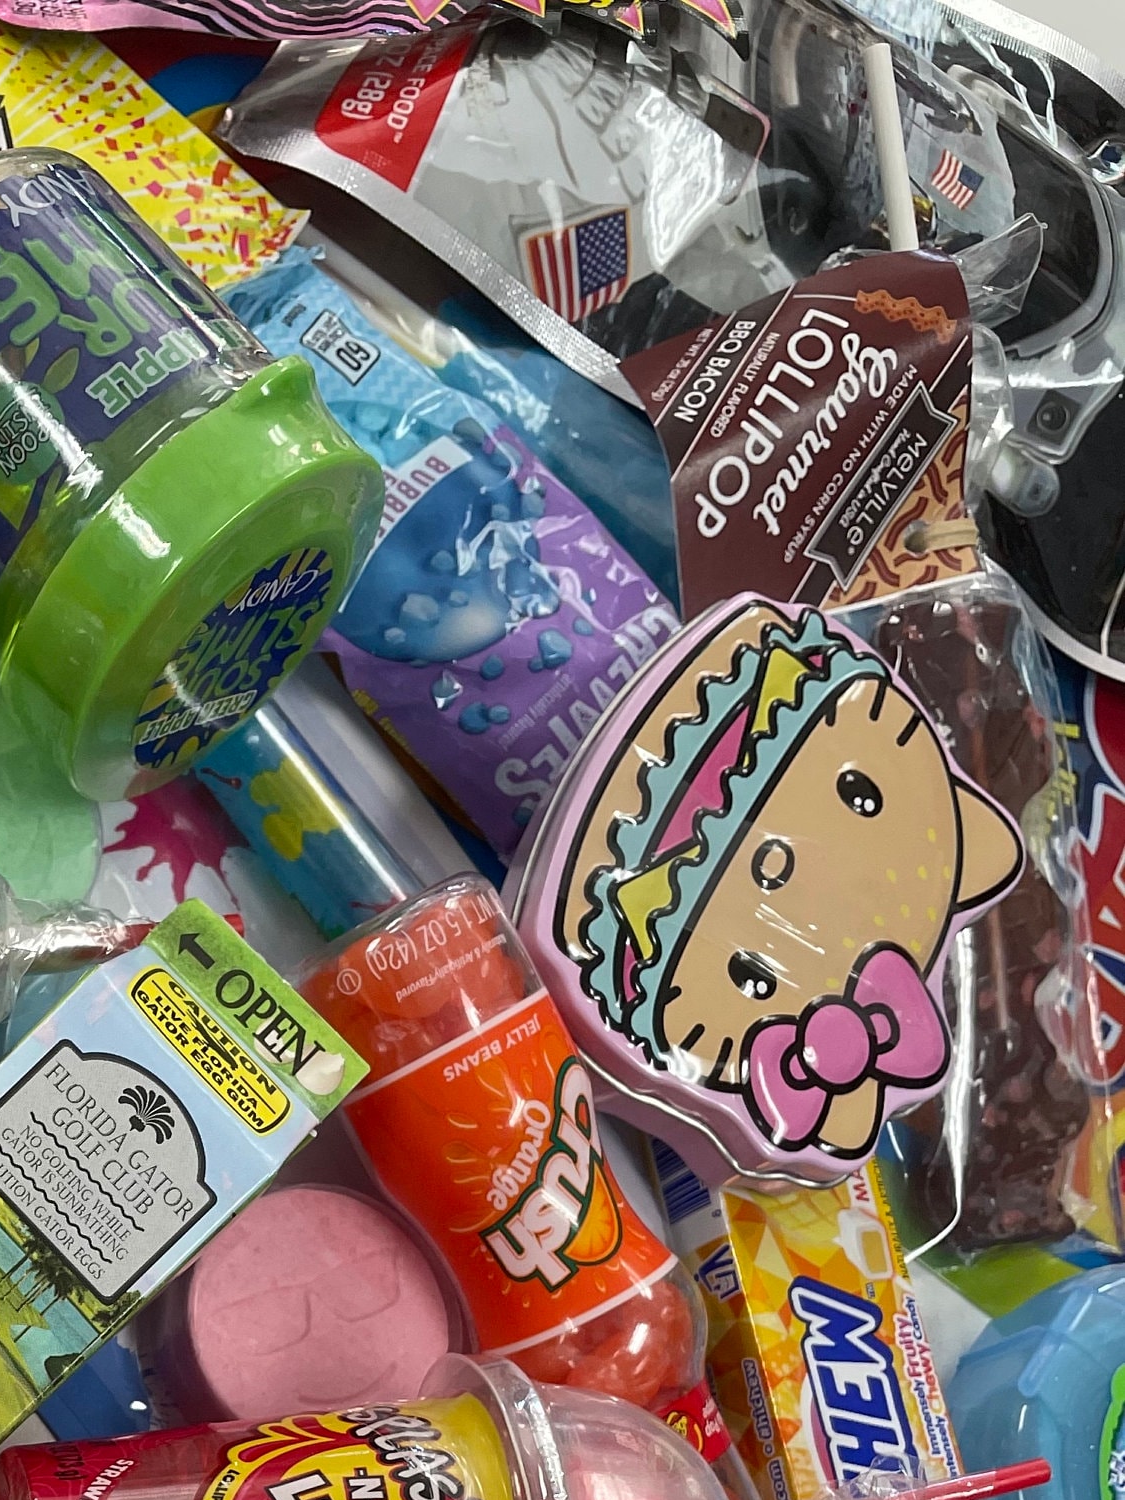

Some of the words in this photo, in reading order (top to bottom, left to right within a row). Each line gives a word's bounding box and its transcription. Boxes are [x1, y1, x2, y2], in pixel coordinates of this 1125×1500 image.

[340, 72, 393, 119] (28g)
[387, 76, 427, 129] FOOD
[723, 320, 756, 353] BBQ
[749, 332, 780, 383] NATURALLY
[674, 357, 731, 422] BACON
[710, 382, 749, 438] FLAVORED
[886, 364, 918, 409] MADE
[695, 308, 850, 538] LOLLIPOP
[753, 333, 898, 535] Gourmet
[861, 410, 888, 451] WITH
[842, 448, 862, 472] NO
[812, 472, 844, 516] CORN
[784, 515, 816, 563] SYRUP
[228, 567, 321, 614] CANDY
[153, 996, 192, 1039] LIVE
[190, 1037, 260, 1111] FLORIDA
[167, 980, 278, 1095] CAUTION
[214, 967, 324, 1078] OPEN
[501, 1012, 542, 1053] JELLY
[136, 990, 191, 1053] GATOR
[188, 1048, 226, 1095] EGG
[224, 1087, 265, 1131] GUM
[442, 1038, 502, 1083] BEANS
[43, 1062, 127, 1155] FLORIDA
[127, 1148, 195, 1222] GATOR
[50, 1106, 105, 1162] GOLF
[100, 1161, 155, 1217] CLUB
[480, 1056, 604, 1291] Crush
[486, 1098, 551, 1212] Orange
[0, 1127, 44, 1173] GATOR
[50, 1181, 130, 1262] SUNBATHING
[19, 1124, 37, 1145] NO
[33, 1138, 92, 1204] GOLFING
[90, 1194, 133, 1242] WHILE
[33, 1204, 75, 1251] GATOR
[72, 1245, 106, 1281] EGGS
[893, 1313, 923, 1379] Fruity
[911, 1376, 941, 1456] Immensely
